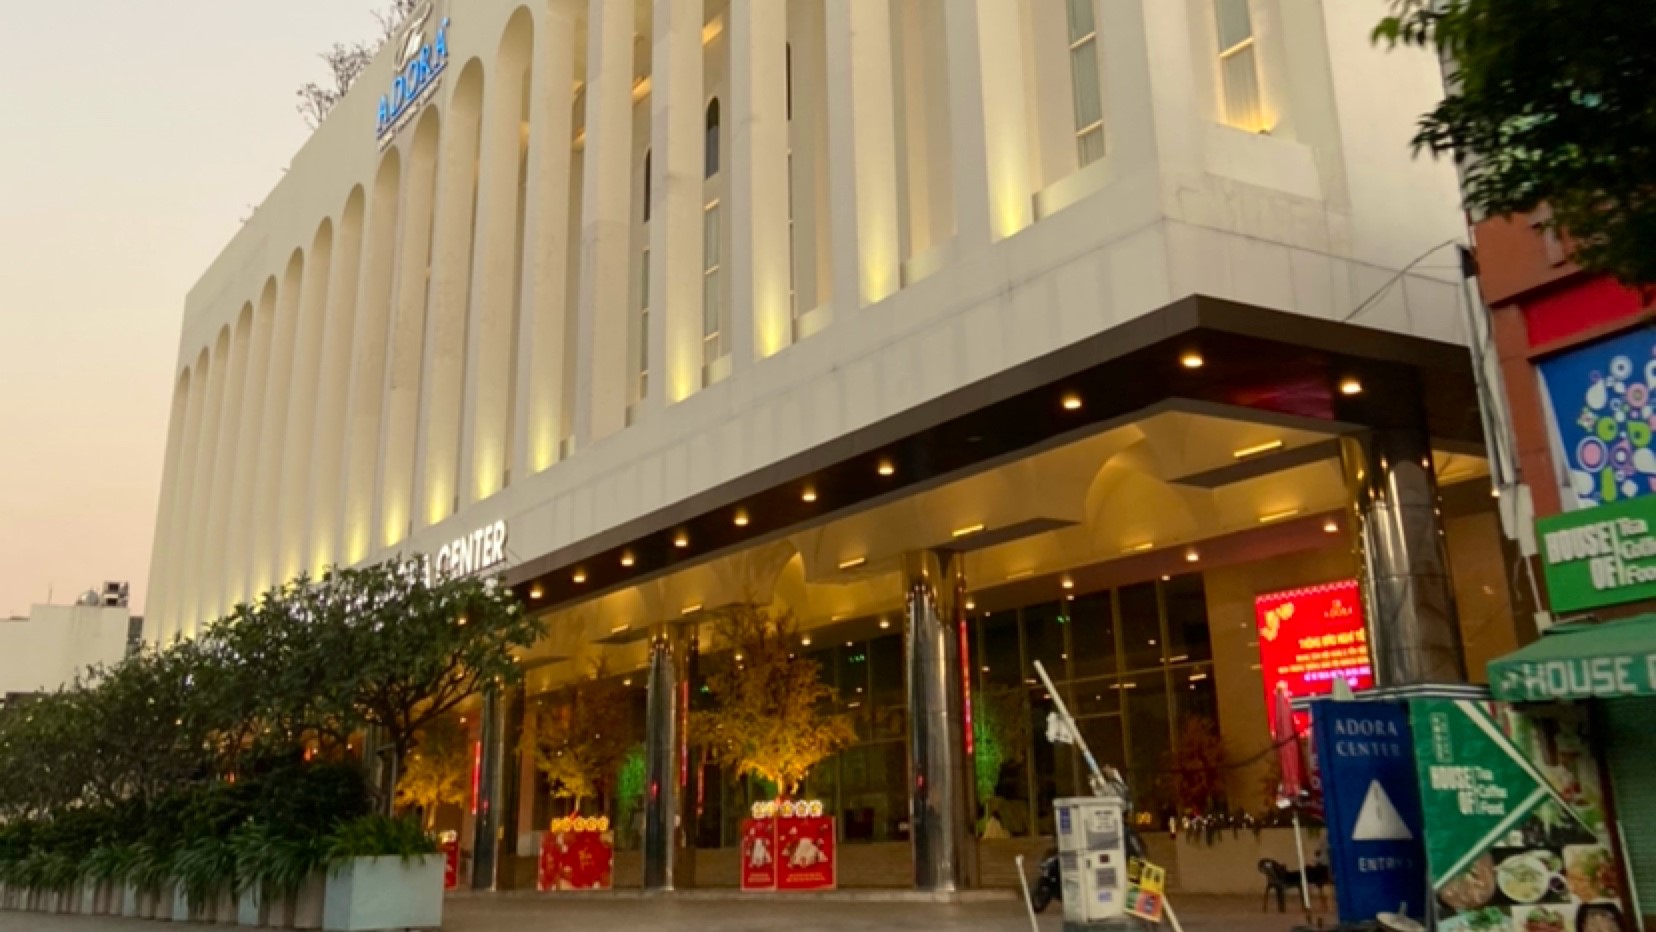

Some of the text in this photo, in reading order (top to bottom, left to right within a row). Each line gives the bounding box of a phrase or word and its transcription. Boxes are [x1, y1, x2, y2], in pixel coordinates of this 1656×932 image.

[376, 24, 448, 134] ADORA
[435, 519, 505, 584] CENTER
[1543, 521, 1614, 564] HOUSE
[1521, 656, 1638, 700] HOUSE
[1334, 720, 1398, 737] ADORA
[1335, 740, 1401, 757] CENTER
